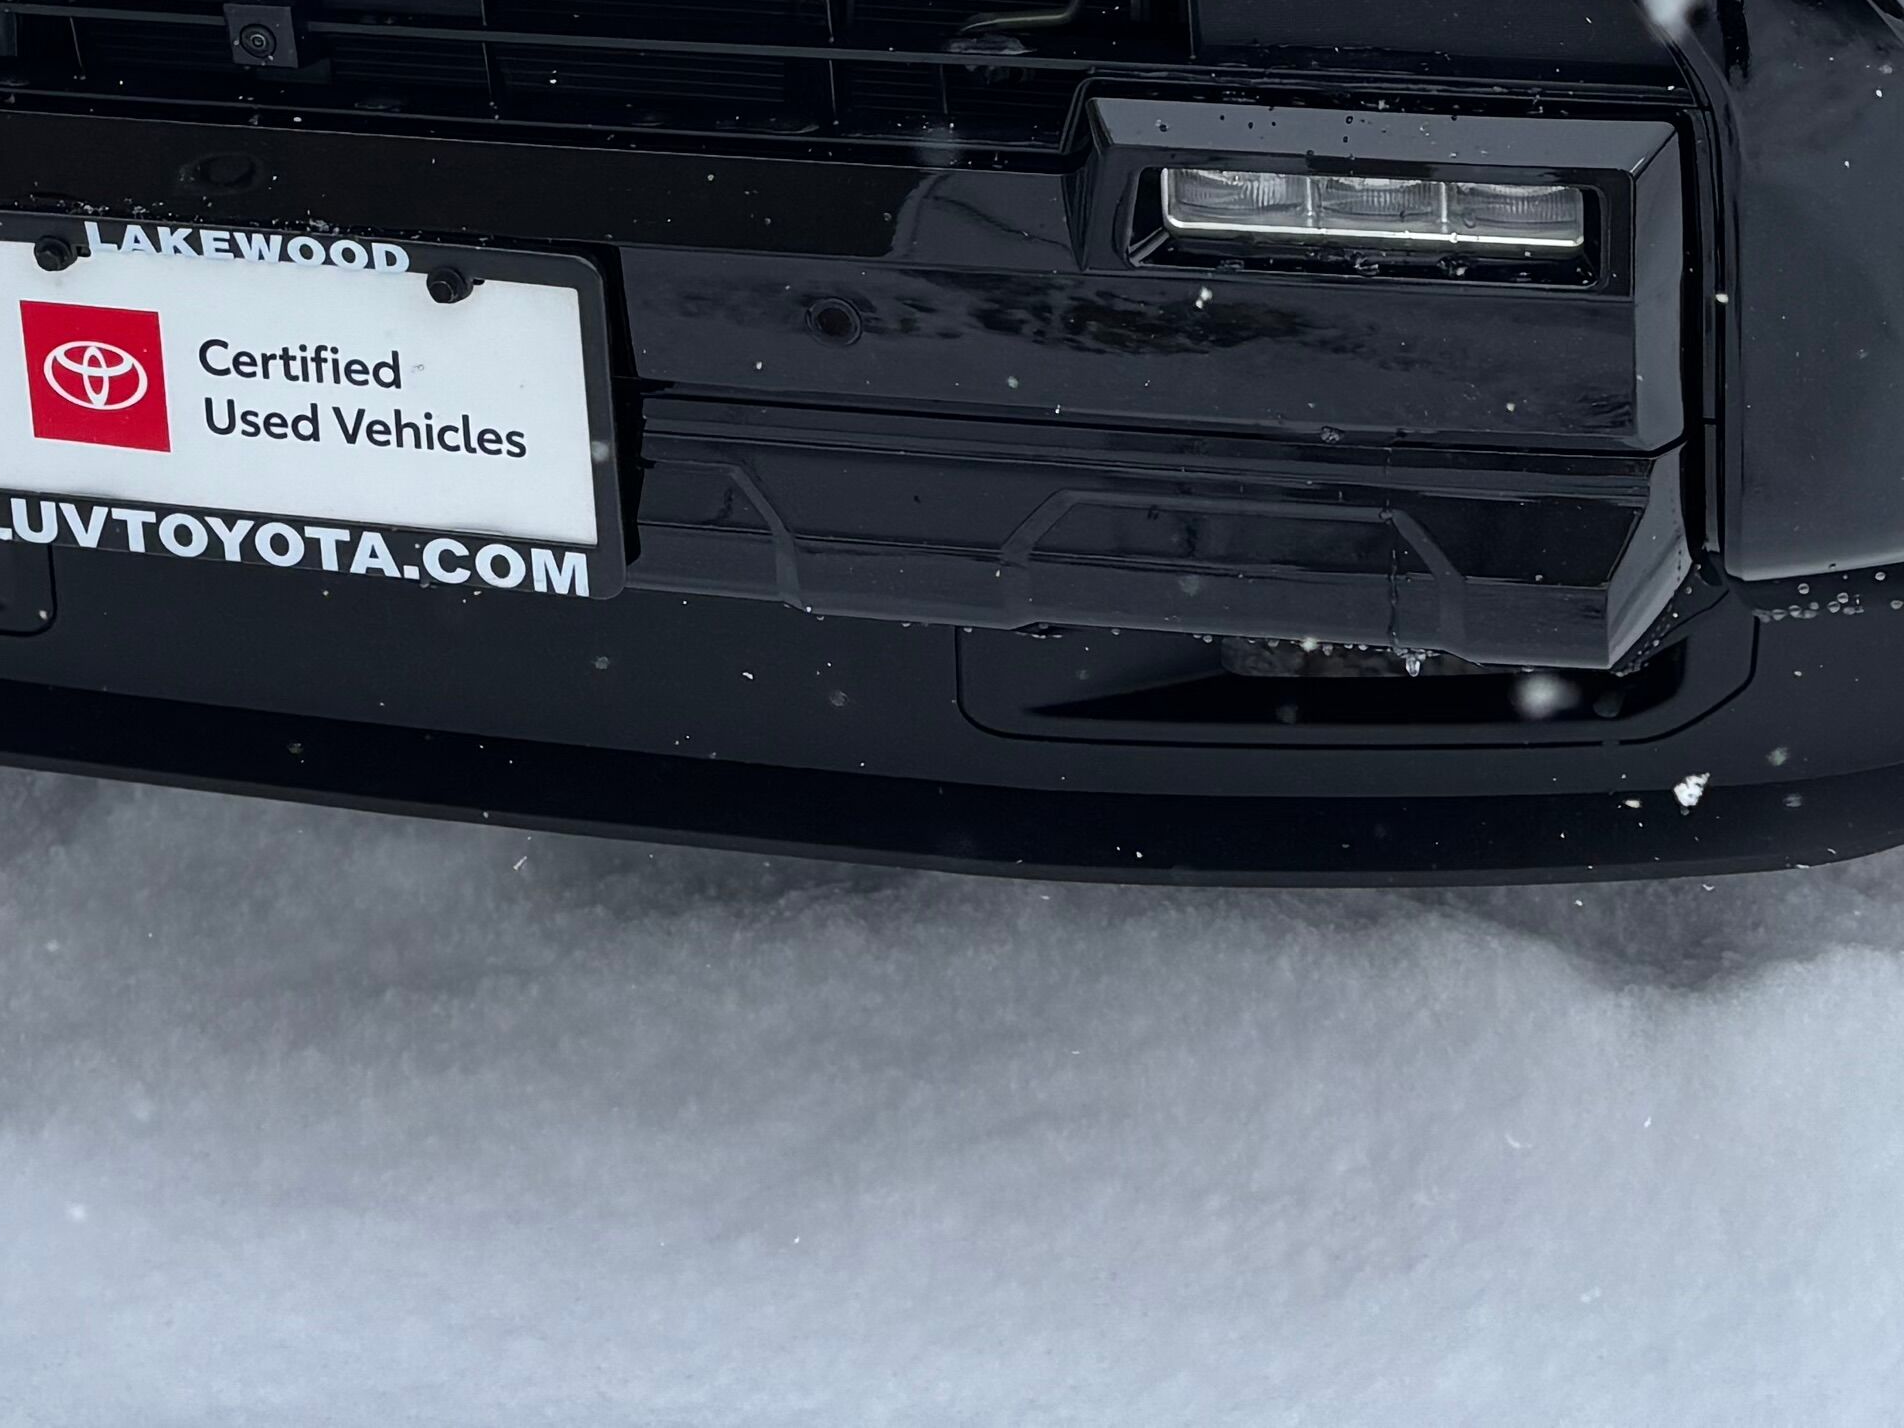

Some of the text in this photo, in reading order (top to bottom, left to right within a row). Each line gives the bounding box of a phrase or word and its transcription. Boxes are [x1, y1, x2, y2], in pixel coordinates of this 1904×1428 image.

[84, 222, 410, 274] LAKEWOOD
[198, 338, 402, 390] Certified
[204, 398, 528, 459] Used Vehicles
